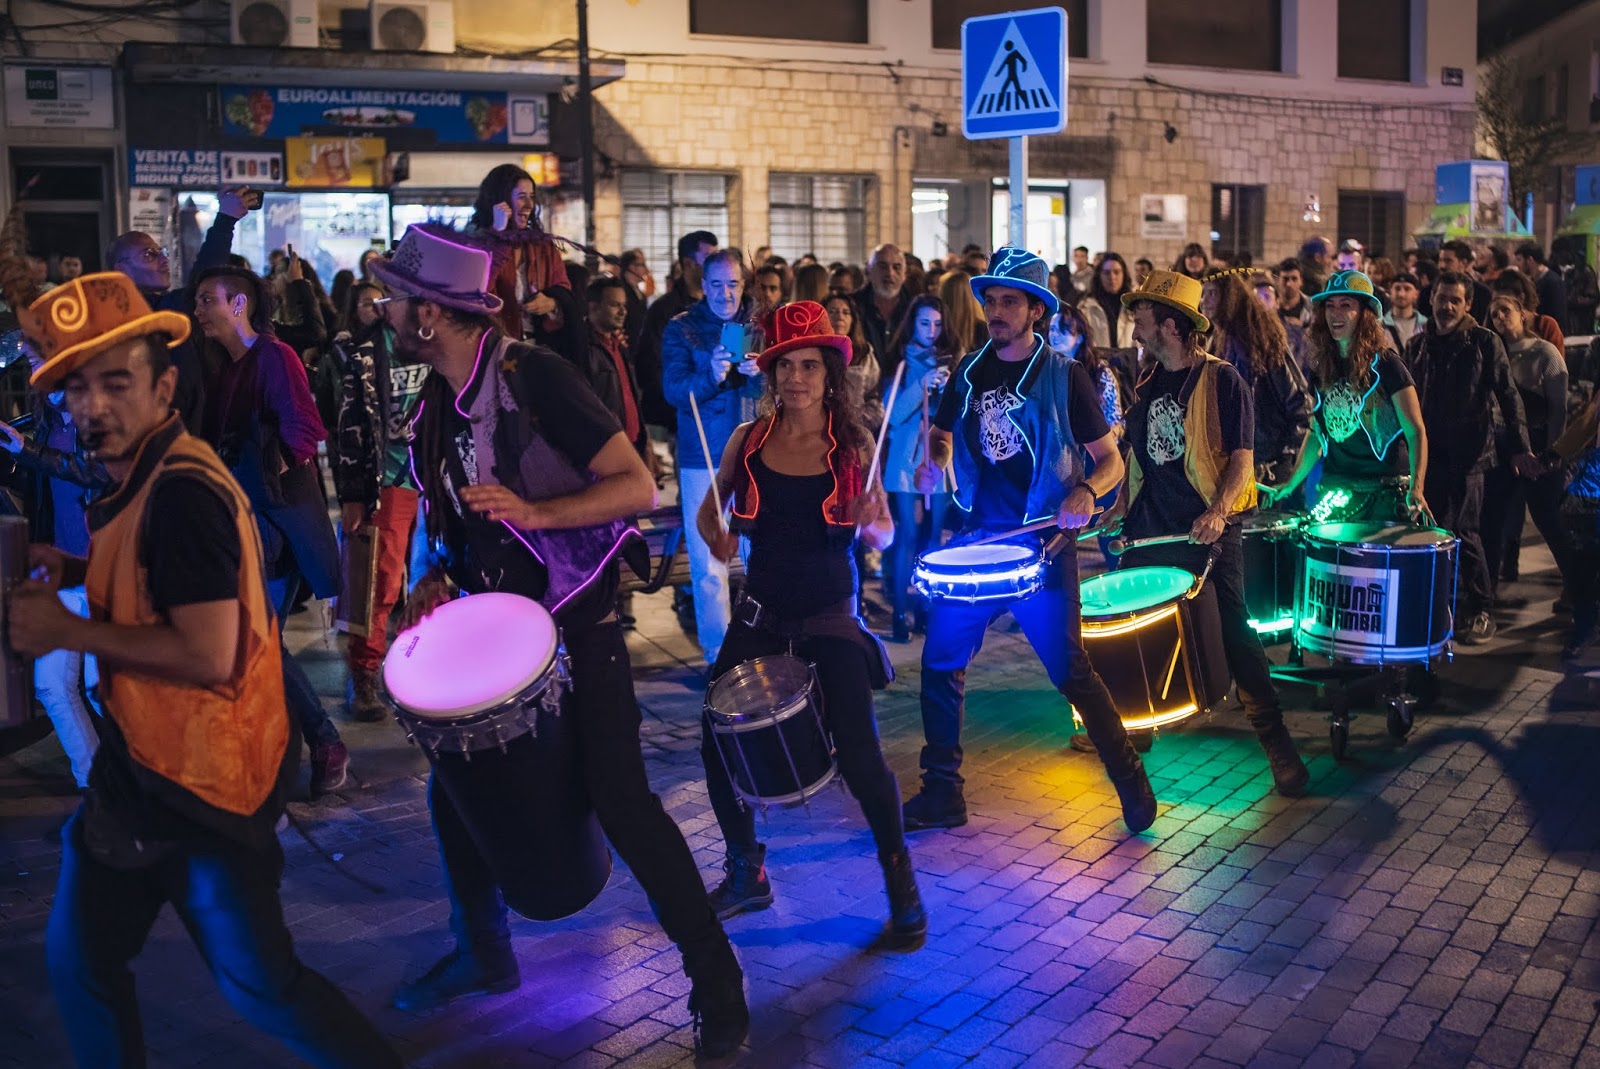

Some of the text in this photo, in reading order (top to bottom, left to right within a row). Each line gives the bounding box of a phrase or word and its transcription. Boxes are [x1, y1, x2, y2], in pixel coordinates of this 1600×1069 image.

[135, 149, 218, 163] VENTA DE
[136, 174, 219, 185] INDIAN SPICE
